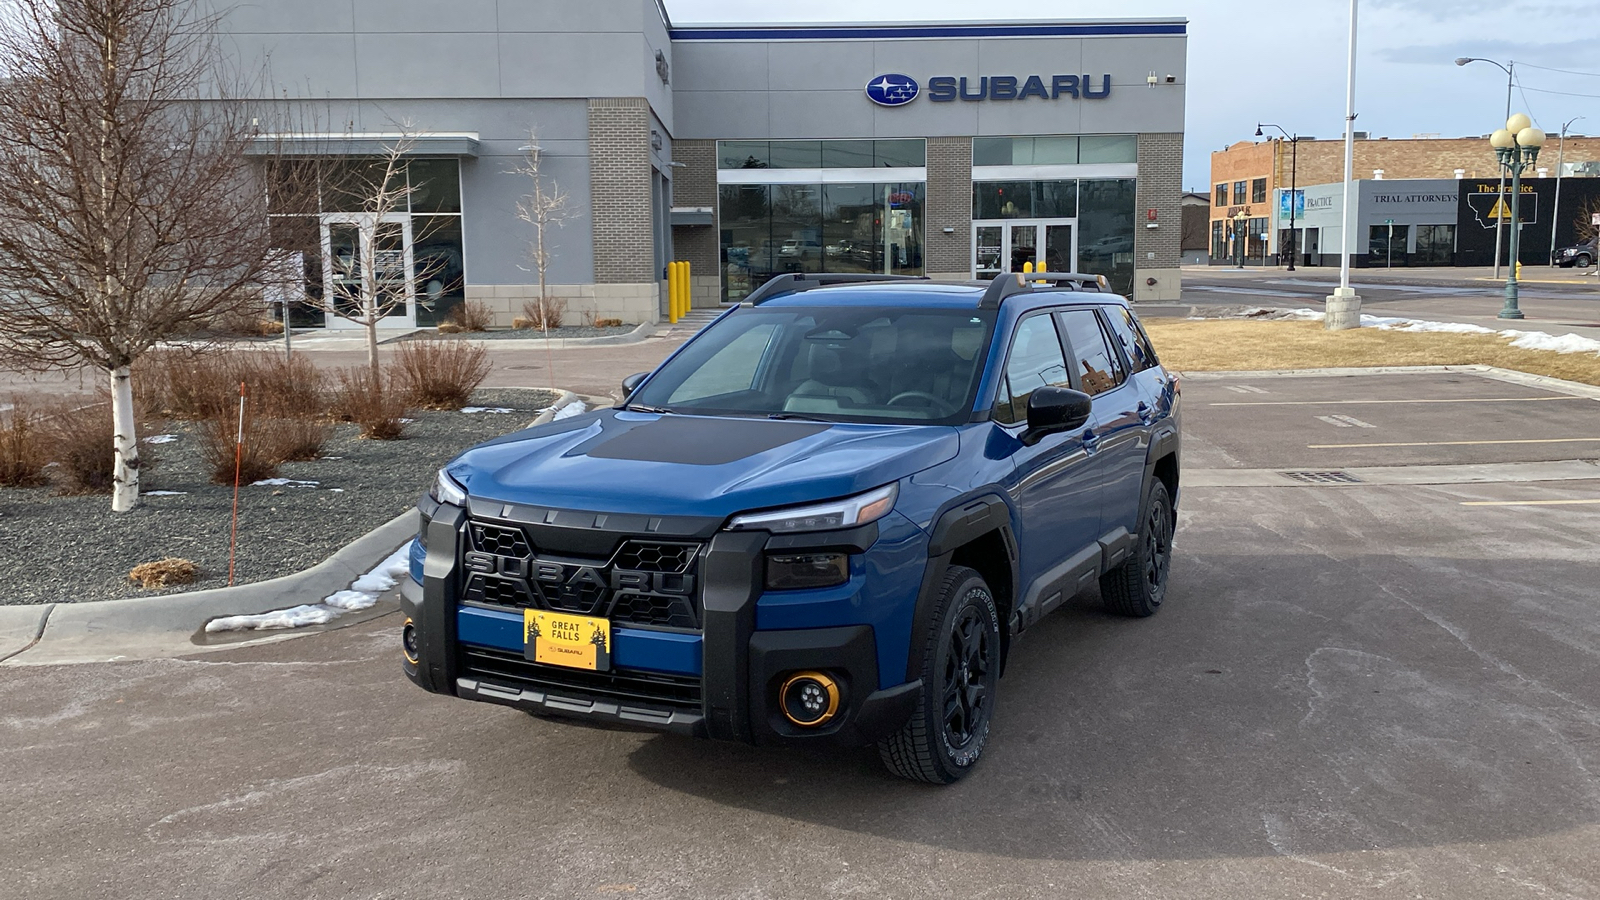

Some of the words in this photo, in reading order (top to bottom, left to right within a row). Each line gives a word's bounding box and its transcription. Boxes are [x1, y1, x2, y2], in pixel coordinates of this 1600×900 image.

[928, 74, 1110, 102] SUBARU
[1477, 184, 1495, 193] The
[1307, 196, 1333, 208] PRACTICE
[1374, 195, 1402, 203] TRIAL
[1404, 194, 1458, 203] ATTORNEYS
[464, 551, 695, 595] SUBARU
[551, 620, 580, 632] GREAT
[551, 630, 580, 641] FALLS
[557, 647, 583, 656] SUBARU
